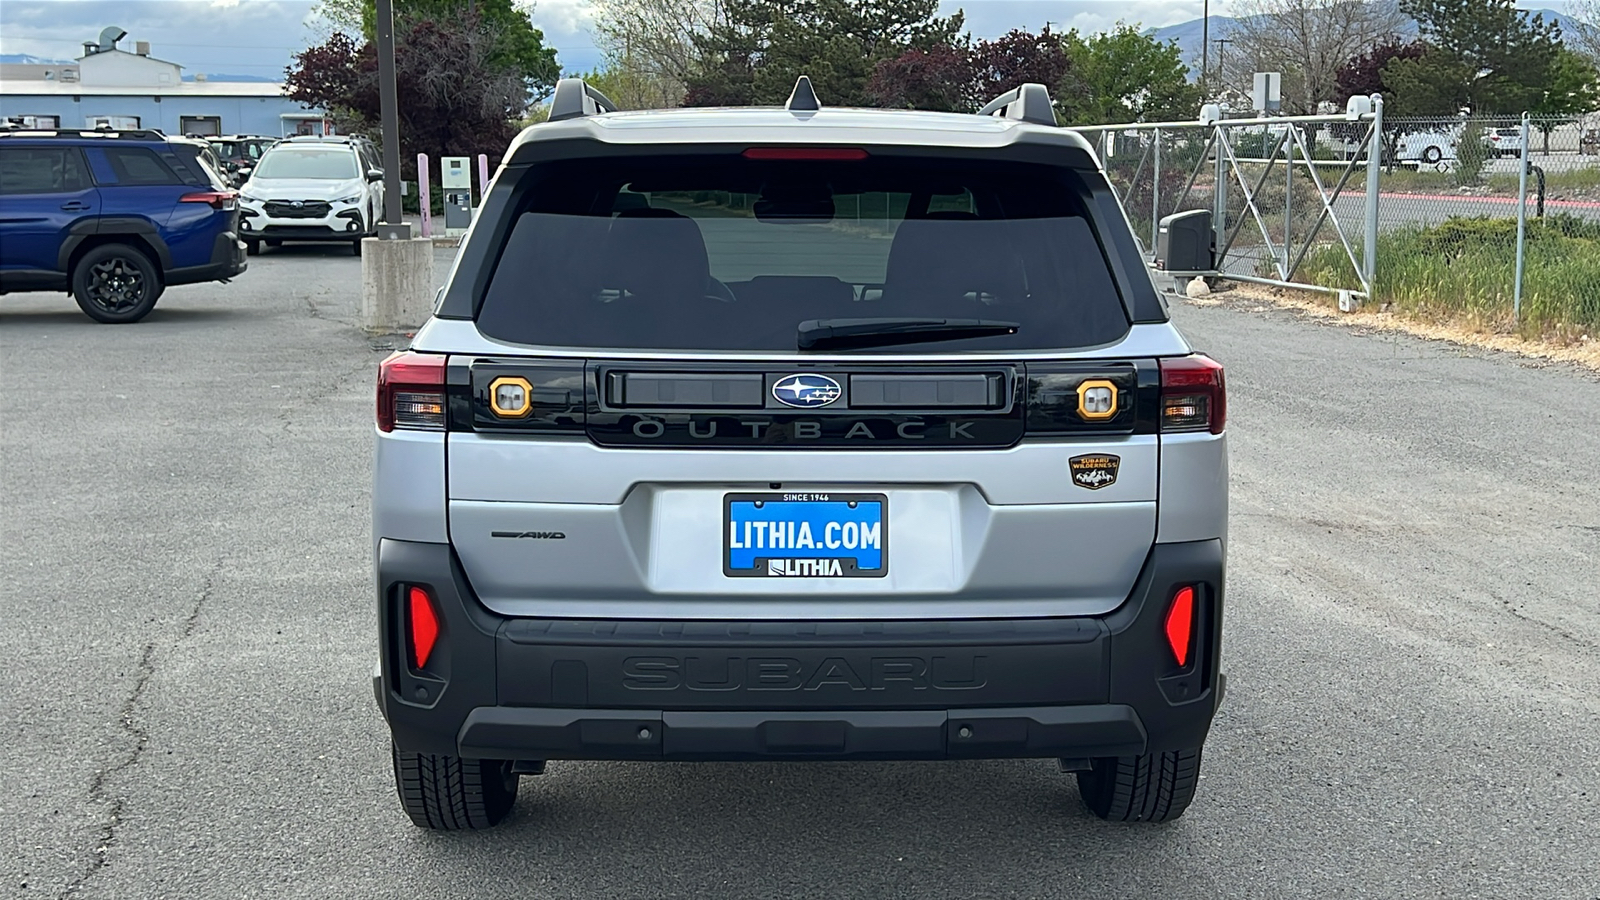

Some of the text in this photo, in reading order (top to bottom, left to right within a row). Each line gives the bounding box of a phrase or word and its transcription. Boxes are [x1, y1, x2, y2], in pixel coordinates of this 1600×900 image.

[632, 420, 975, 440] OUTBACK
[783, 493, 829, 502] SINCE 1946
[518, 531, 566, 539] AWD
[730, 520, 881, 550] LITHIA.COM
[785, 558, 843, 576] LITHIA
[621, 655, 988, 691] SUBARU
